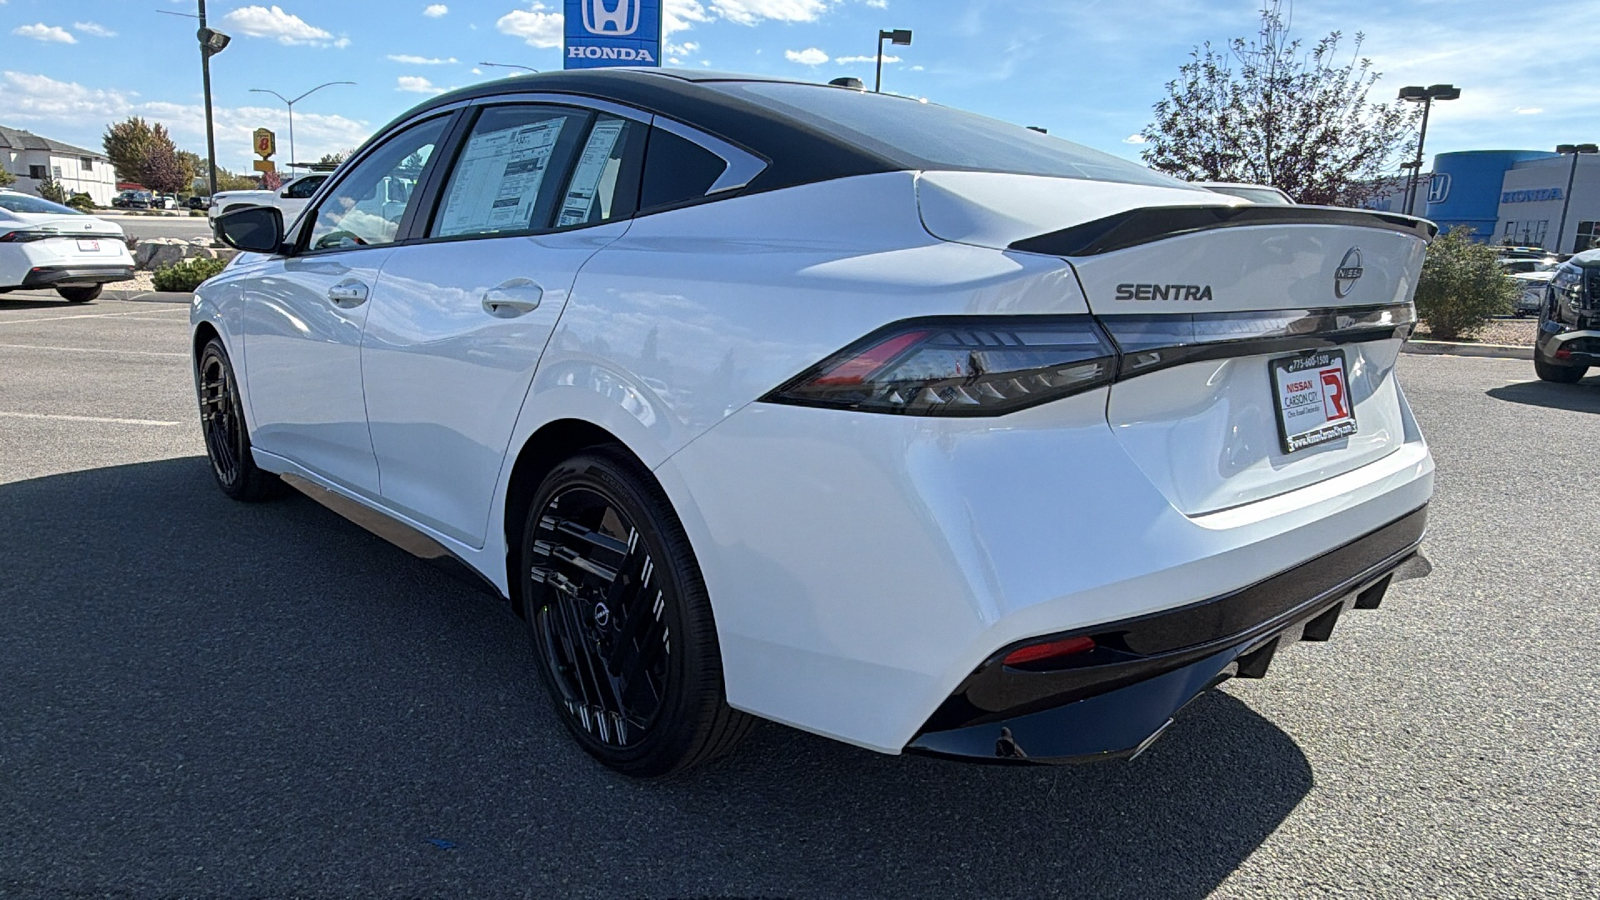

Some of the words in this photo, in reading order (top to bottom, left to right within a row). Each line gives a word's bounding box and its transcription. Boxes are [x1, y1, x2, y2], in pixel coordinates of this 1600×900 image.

[567, 46, 655, 62] HONDA
[1501, 187, 1565, 204] HONDA
[1115, 283, 1213, 301] SENTRA
[1286, 380, 1313, 394] NISSAN
[1284, 393, 1308, 408] CARSON
[1308, 391, 1318, 403] CITY
